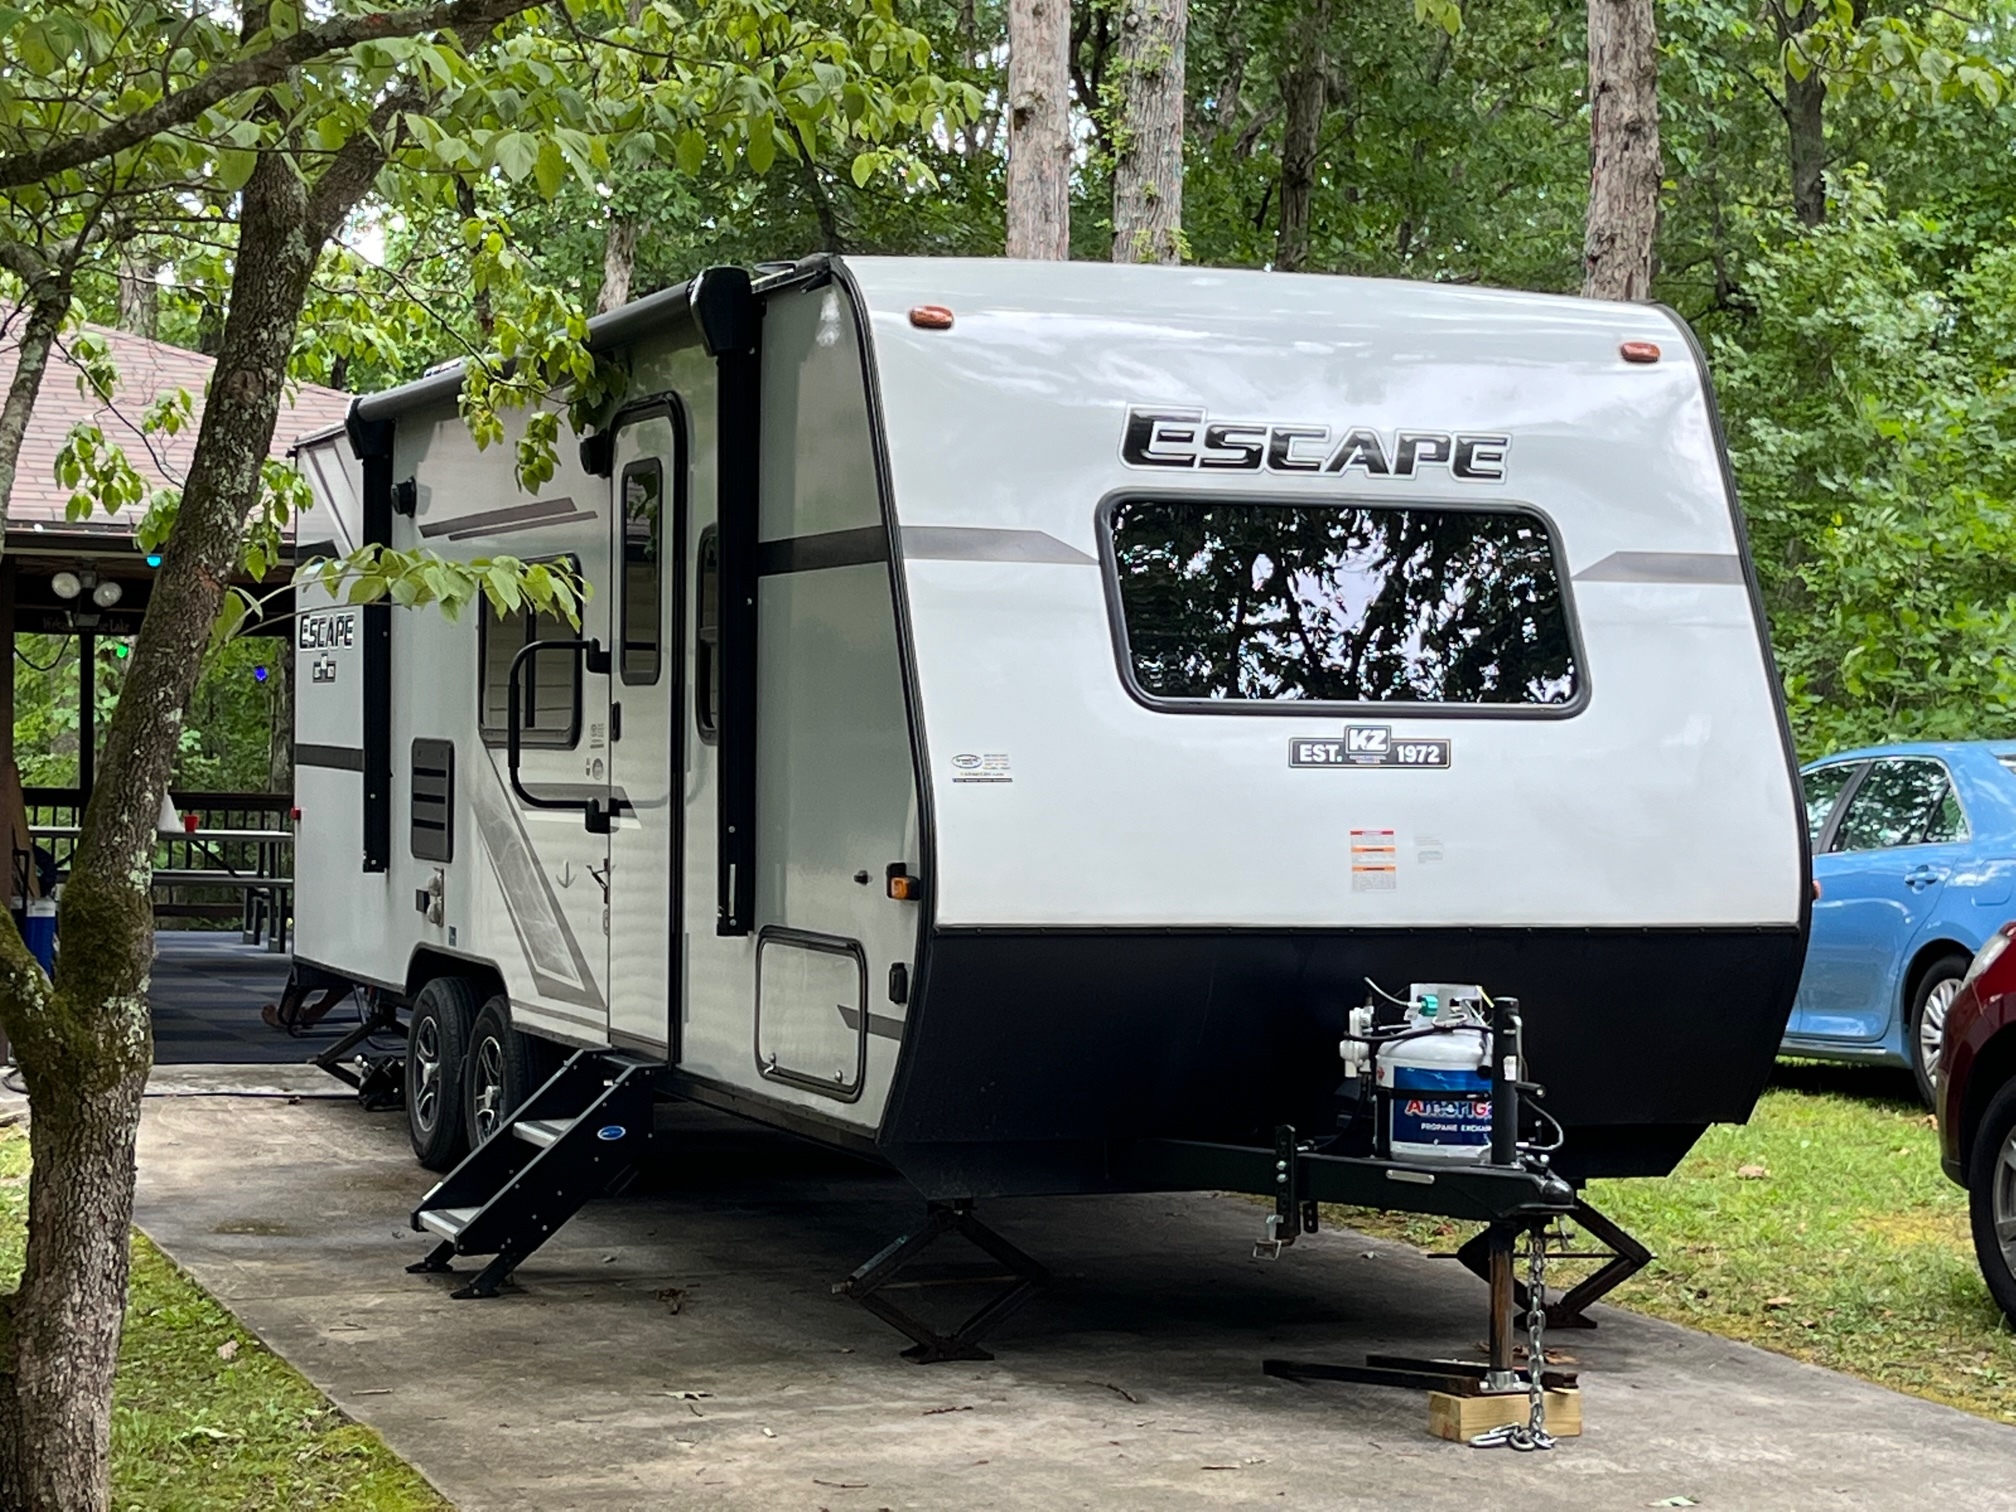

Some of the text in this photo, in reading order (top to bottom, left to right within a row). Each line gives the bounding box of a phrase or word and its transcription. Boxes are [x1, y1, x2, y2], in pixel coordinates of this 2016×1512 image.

[1119, 406, 1510, 480] ESCAPE
[299, 613, 355, 650] ESCAPE
[1349, 728, 1387, 751] KZ
[1299, 743, 1343, 763] EST.
[1396, 744, 1441, 764] 1972
[1404, 1099, 1492, 1119] AmeriG
[1420, 1122, 1458, 1132] PROPANE
